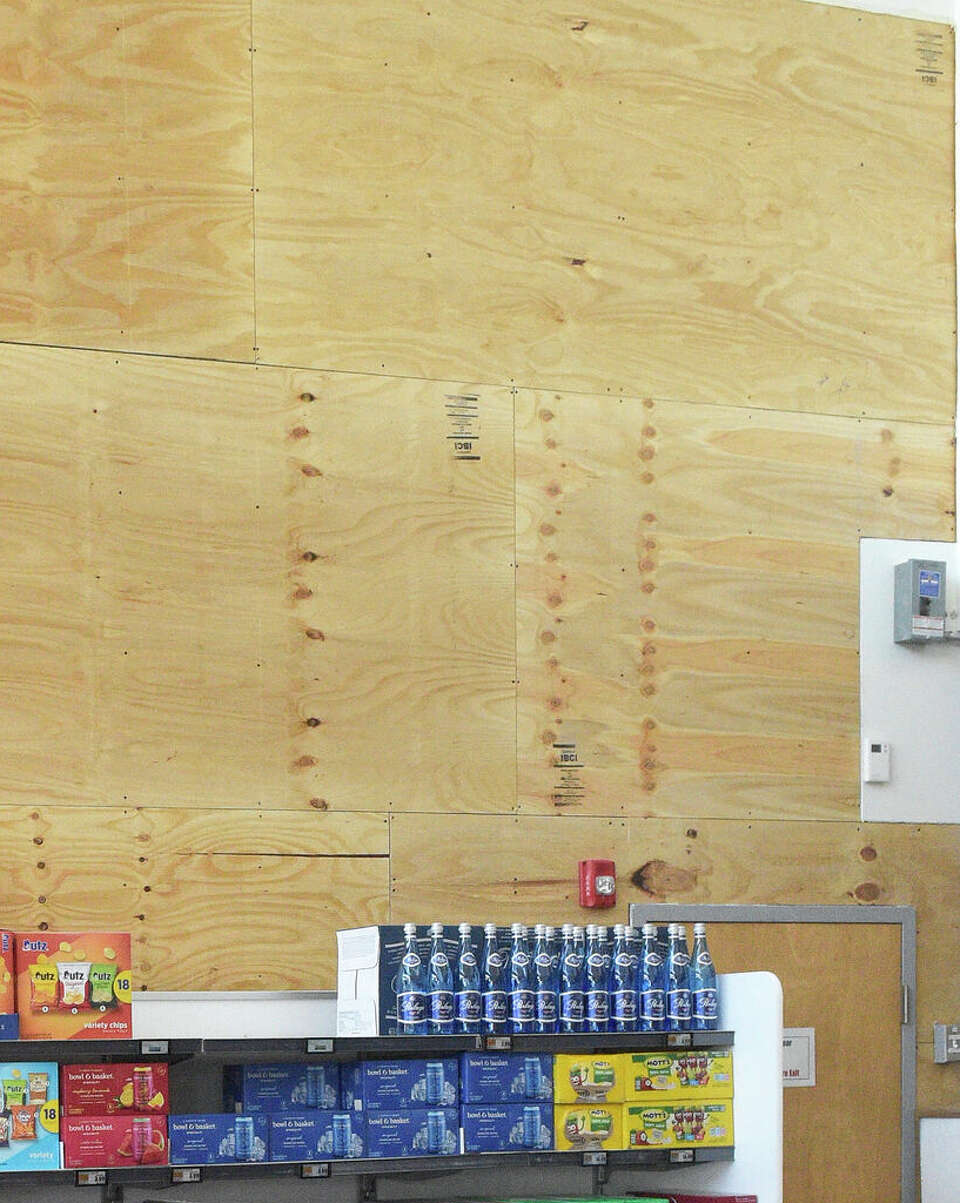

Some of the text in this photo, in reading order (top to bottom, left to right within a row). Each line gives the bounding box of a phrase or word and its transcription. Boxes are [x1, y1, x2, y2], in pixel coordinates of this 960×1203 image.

[117, 979, 129, 990] 18
[109, 1021, 128, 1030] chips
[43, 1108, 56, 1119] 18
